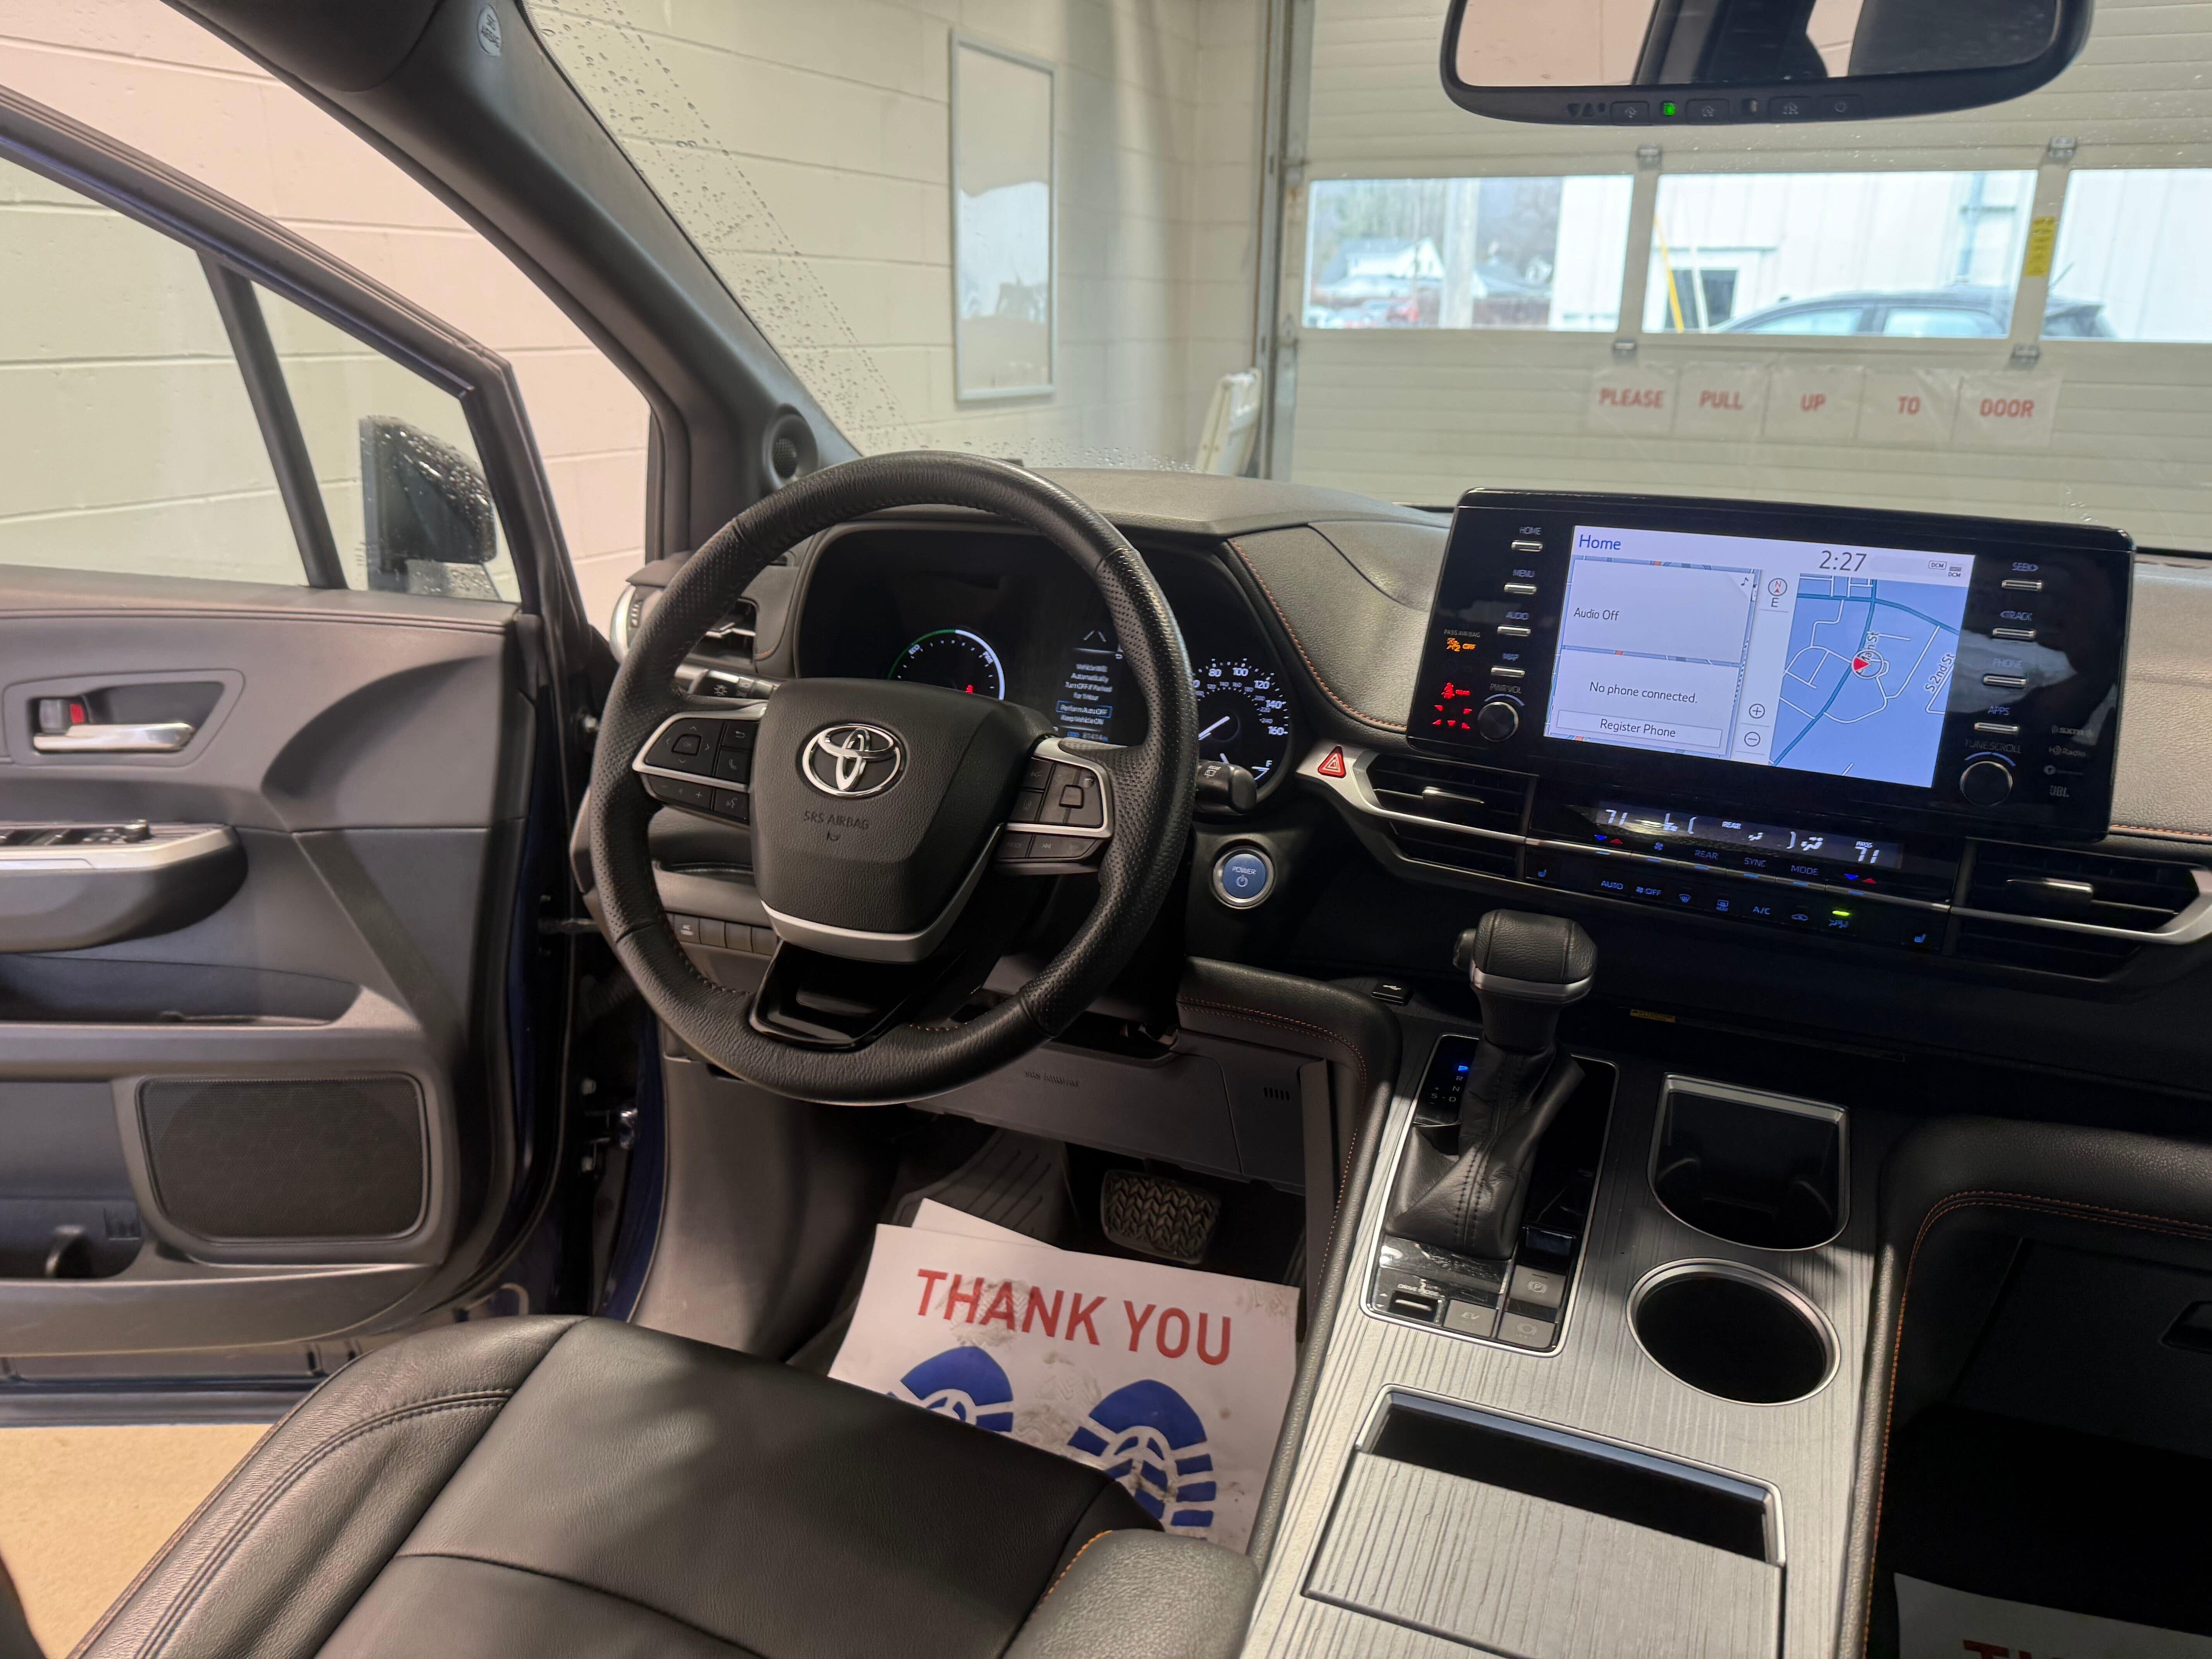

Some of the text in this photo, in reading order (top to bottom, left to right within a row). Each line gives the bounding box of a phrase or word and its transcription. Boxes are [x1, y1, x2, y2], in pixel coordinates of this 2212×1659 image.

[1599, 388, 2034, 417] PLEASE PULL UP TO DOOR
[1519, 527, 1542, 535] HOME
[1578, 534, 1621, 550] Home
[1819, 550, 1867, 572] 2:27
[2012, 562, 2032, 571] SEEK
[1512, 569, 1535, 577] MENU
[1771, 598, 1779, 607] E
[1574, 607, 1620, 621] Audio Off
[1867, 631, 1879, 642] St
[1993, 658, 2023, 668] PHONE
[1208, 668, 1222, 677] 80
[1233, 667, 1249, 676] 100
[1925, 653, 1956, 692] S 2nd St
[1254, 680, 1270, 689] 120
[1590, 682, 1698, 704] No phone connected.
[1266, 700, 1283, 709] 140
[1987, 706, 2010, 716] APPS
[1267, 726, 1284, 735] 160
[1600, 719, 1676, 737] Register Phone
[1965, 739, 2021, 754] TUNE SCROLL
[2062, 748, 2087, 757] Radio
[2049, 785, 2069, 797] JBL
[804, 811, 869, 830] SRS AIRBAG
[1606, 809, 1627, 825] 71
[1722, 821, 1741, 830] REAR
[1694, 850, 1719, 860] REAR
[1855, 847, 1879, 864] 71
[1744, 857, 1766, 868] SYNC
[1232, 866, 1257, 875] POWER
[1791, 865, 1819, 876] MODE
[1601, 880, 1624, 890] AUTO
[1645, 888, 1662, 896] OFF
[1752, 906, 1770, 915] A/C
[1397, 1283, 1418, 1292] DRIVE
[918, 1269, 1231, 1365] THANK YOU
[1461, 1311, 1480, 1320] EV
